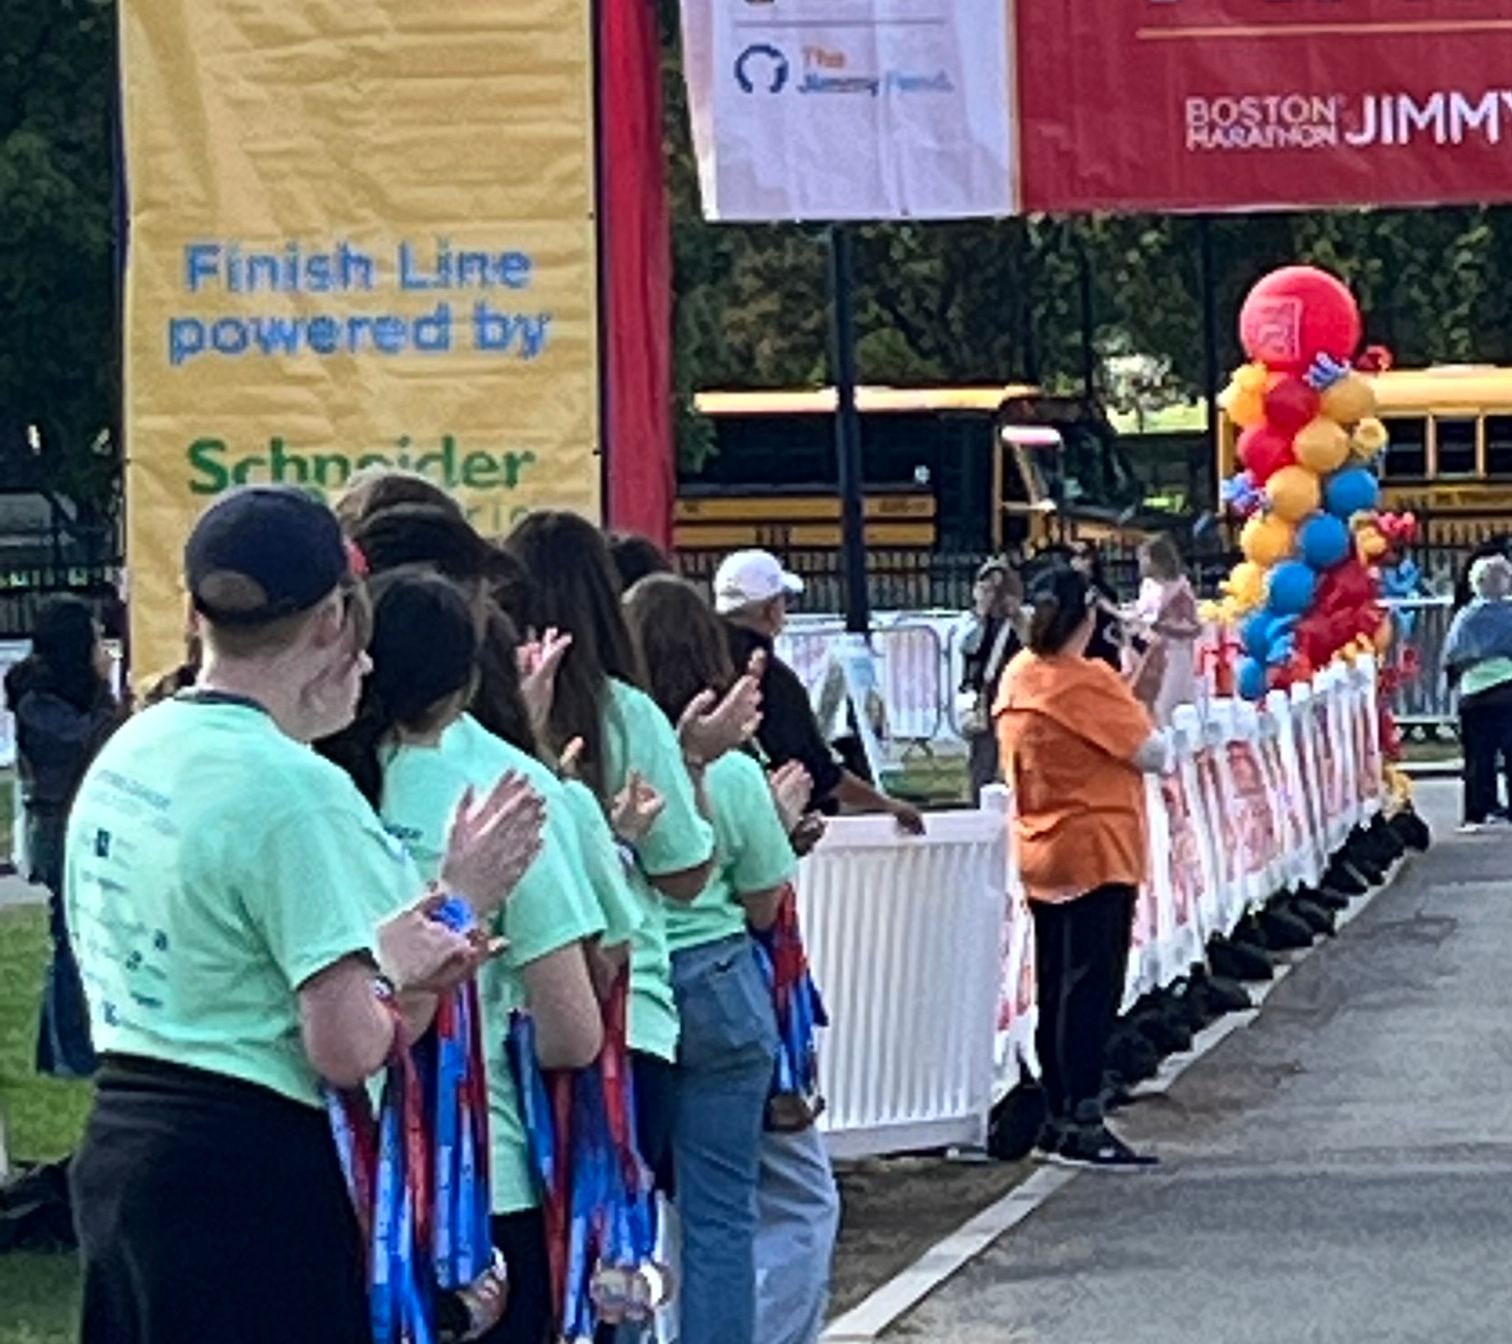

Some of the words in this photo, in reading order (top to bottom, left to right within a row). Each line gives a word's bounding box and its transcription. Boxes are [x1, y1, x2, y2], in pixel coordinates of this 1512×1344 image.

[1185, 94, 1336, 127] BOSTON
[1185, 125, 1338, 151] MARATHON
[185, 239, 374, 293] Finish
[399, 235, 532, 290] Line
[168, 301, 452, 367] powered
[475, 299, 552, 360] by
